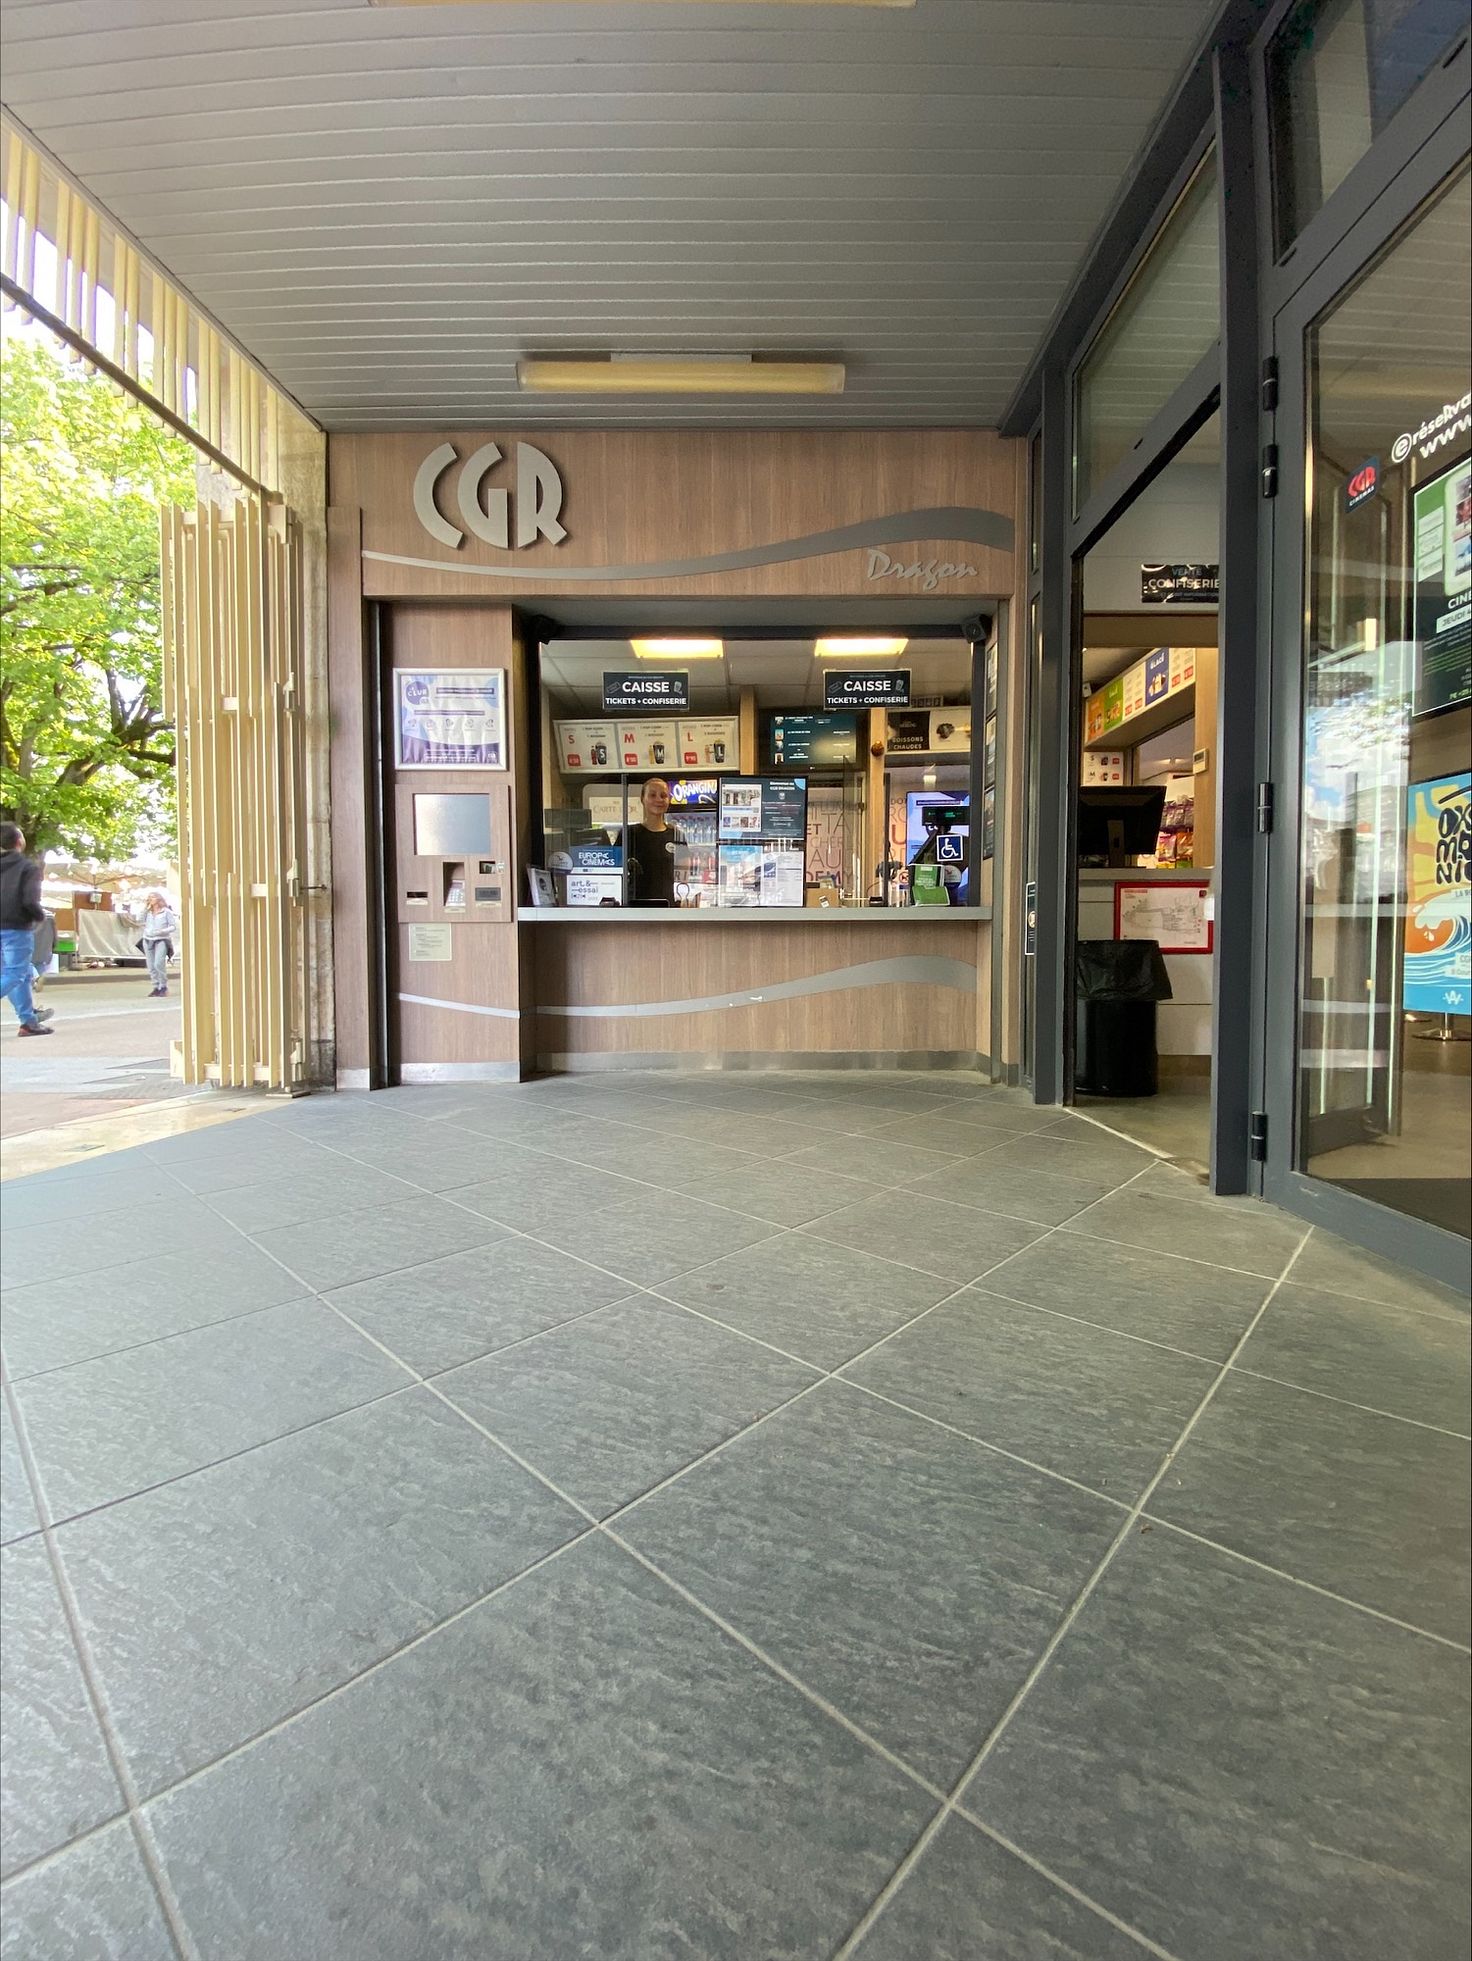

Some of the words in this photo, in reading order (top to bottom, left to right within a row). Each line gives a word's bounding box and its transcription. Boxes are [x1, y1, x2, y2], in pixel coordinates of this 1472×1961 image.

[413, 441, 568, 549] CGR
[867, 548, 978, 590] Dragon
[1171, 567, 1202, 576] VENTE
[1148, 578, 1219, 589] CONFISERIE
[622, 681, 670, 693] CAISSE
[843, 680, 892, 692] CAISSE
[605, 697, 637, 705] TICKETS
[642, 697, 687, 705] CONFISERIE
[827, 696, 858, 704] TICKETS
[863, 696, 909, 704] CONFISERIE
[568, 734, 575, 744] S
[624, 733, 635, 744] M
[687, 732, 694, 742] L
[599, 748, 606, 758] S
[657, 748, 664, 758] M
[718, 746, 724, 756] L
